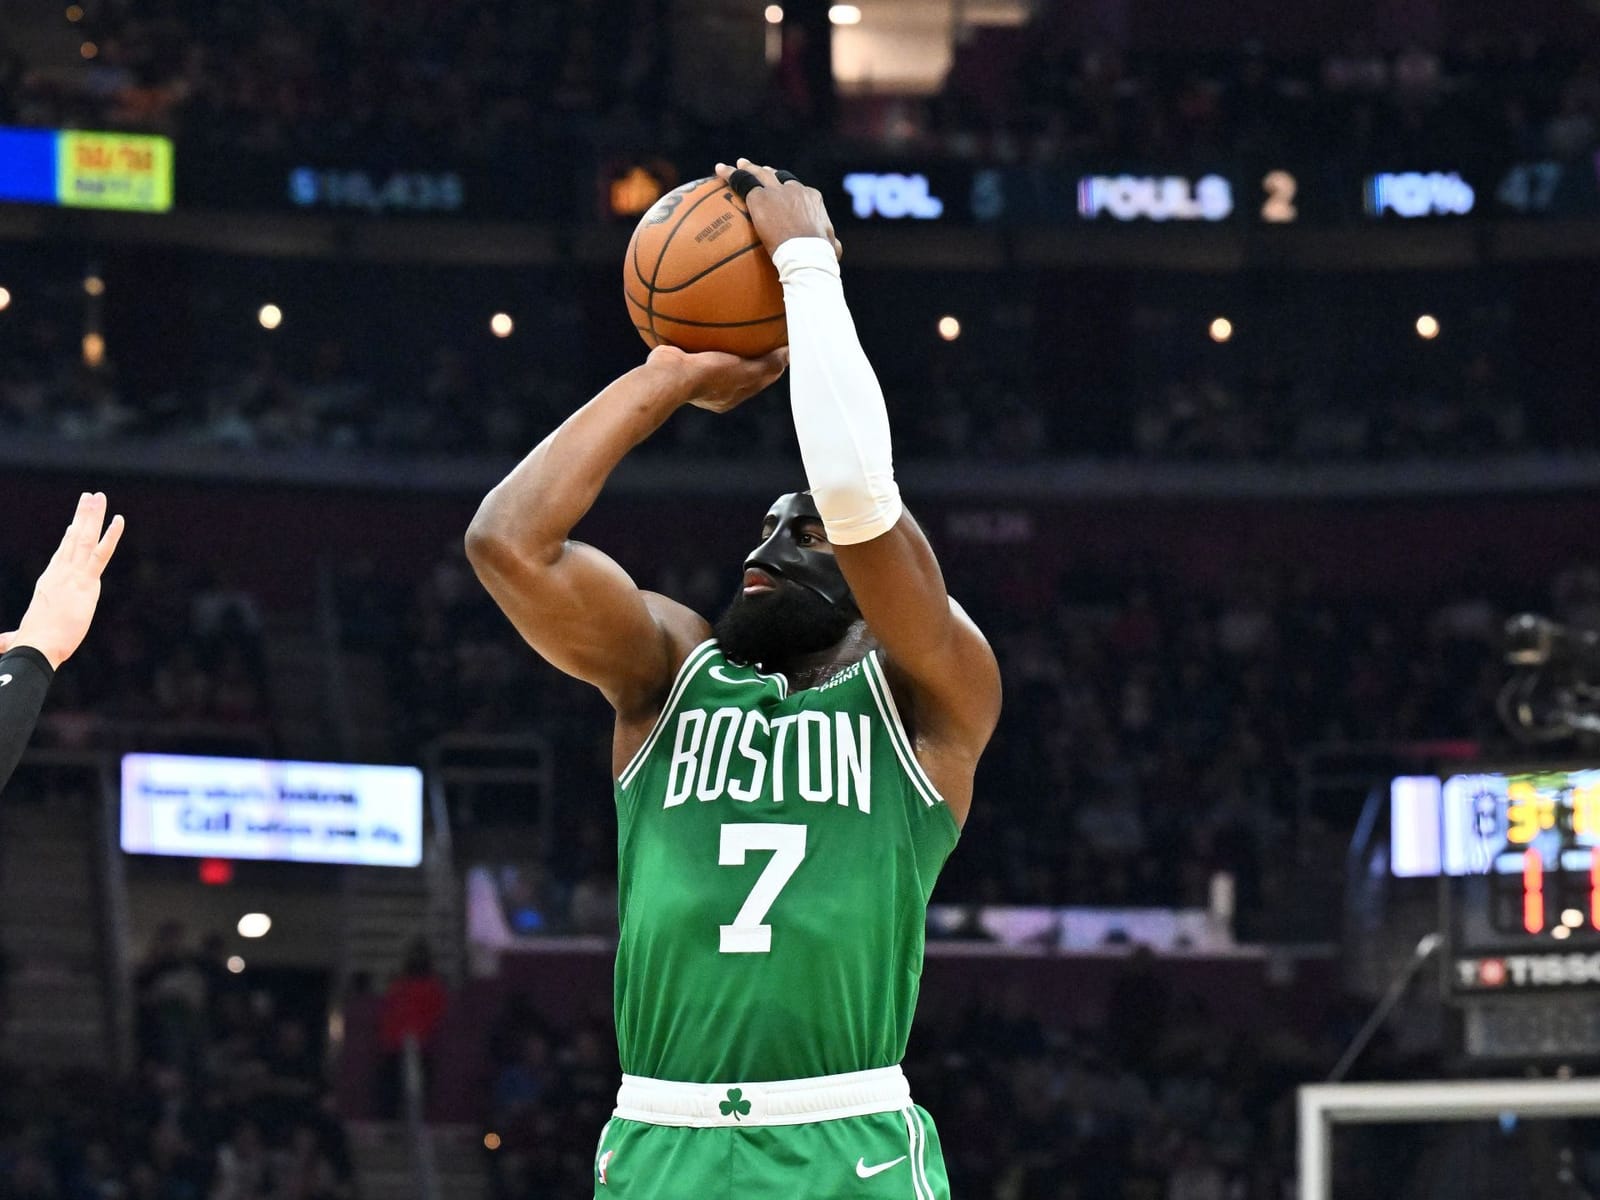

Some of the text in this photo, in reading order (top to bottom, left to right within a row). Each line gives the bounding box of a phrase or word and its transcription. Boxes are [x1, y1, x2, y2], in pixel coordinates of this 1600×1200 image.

[843, 172, 944, 219] TOL
[1260, 170, 1297, 223] 2
[664, 708, 871, 814] BOSTON
[180, 808, 231, 834] Call
[719, 823, 807, 952] 7
